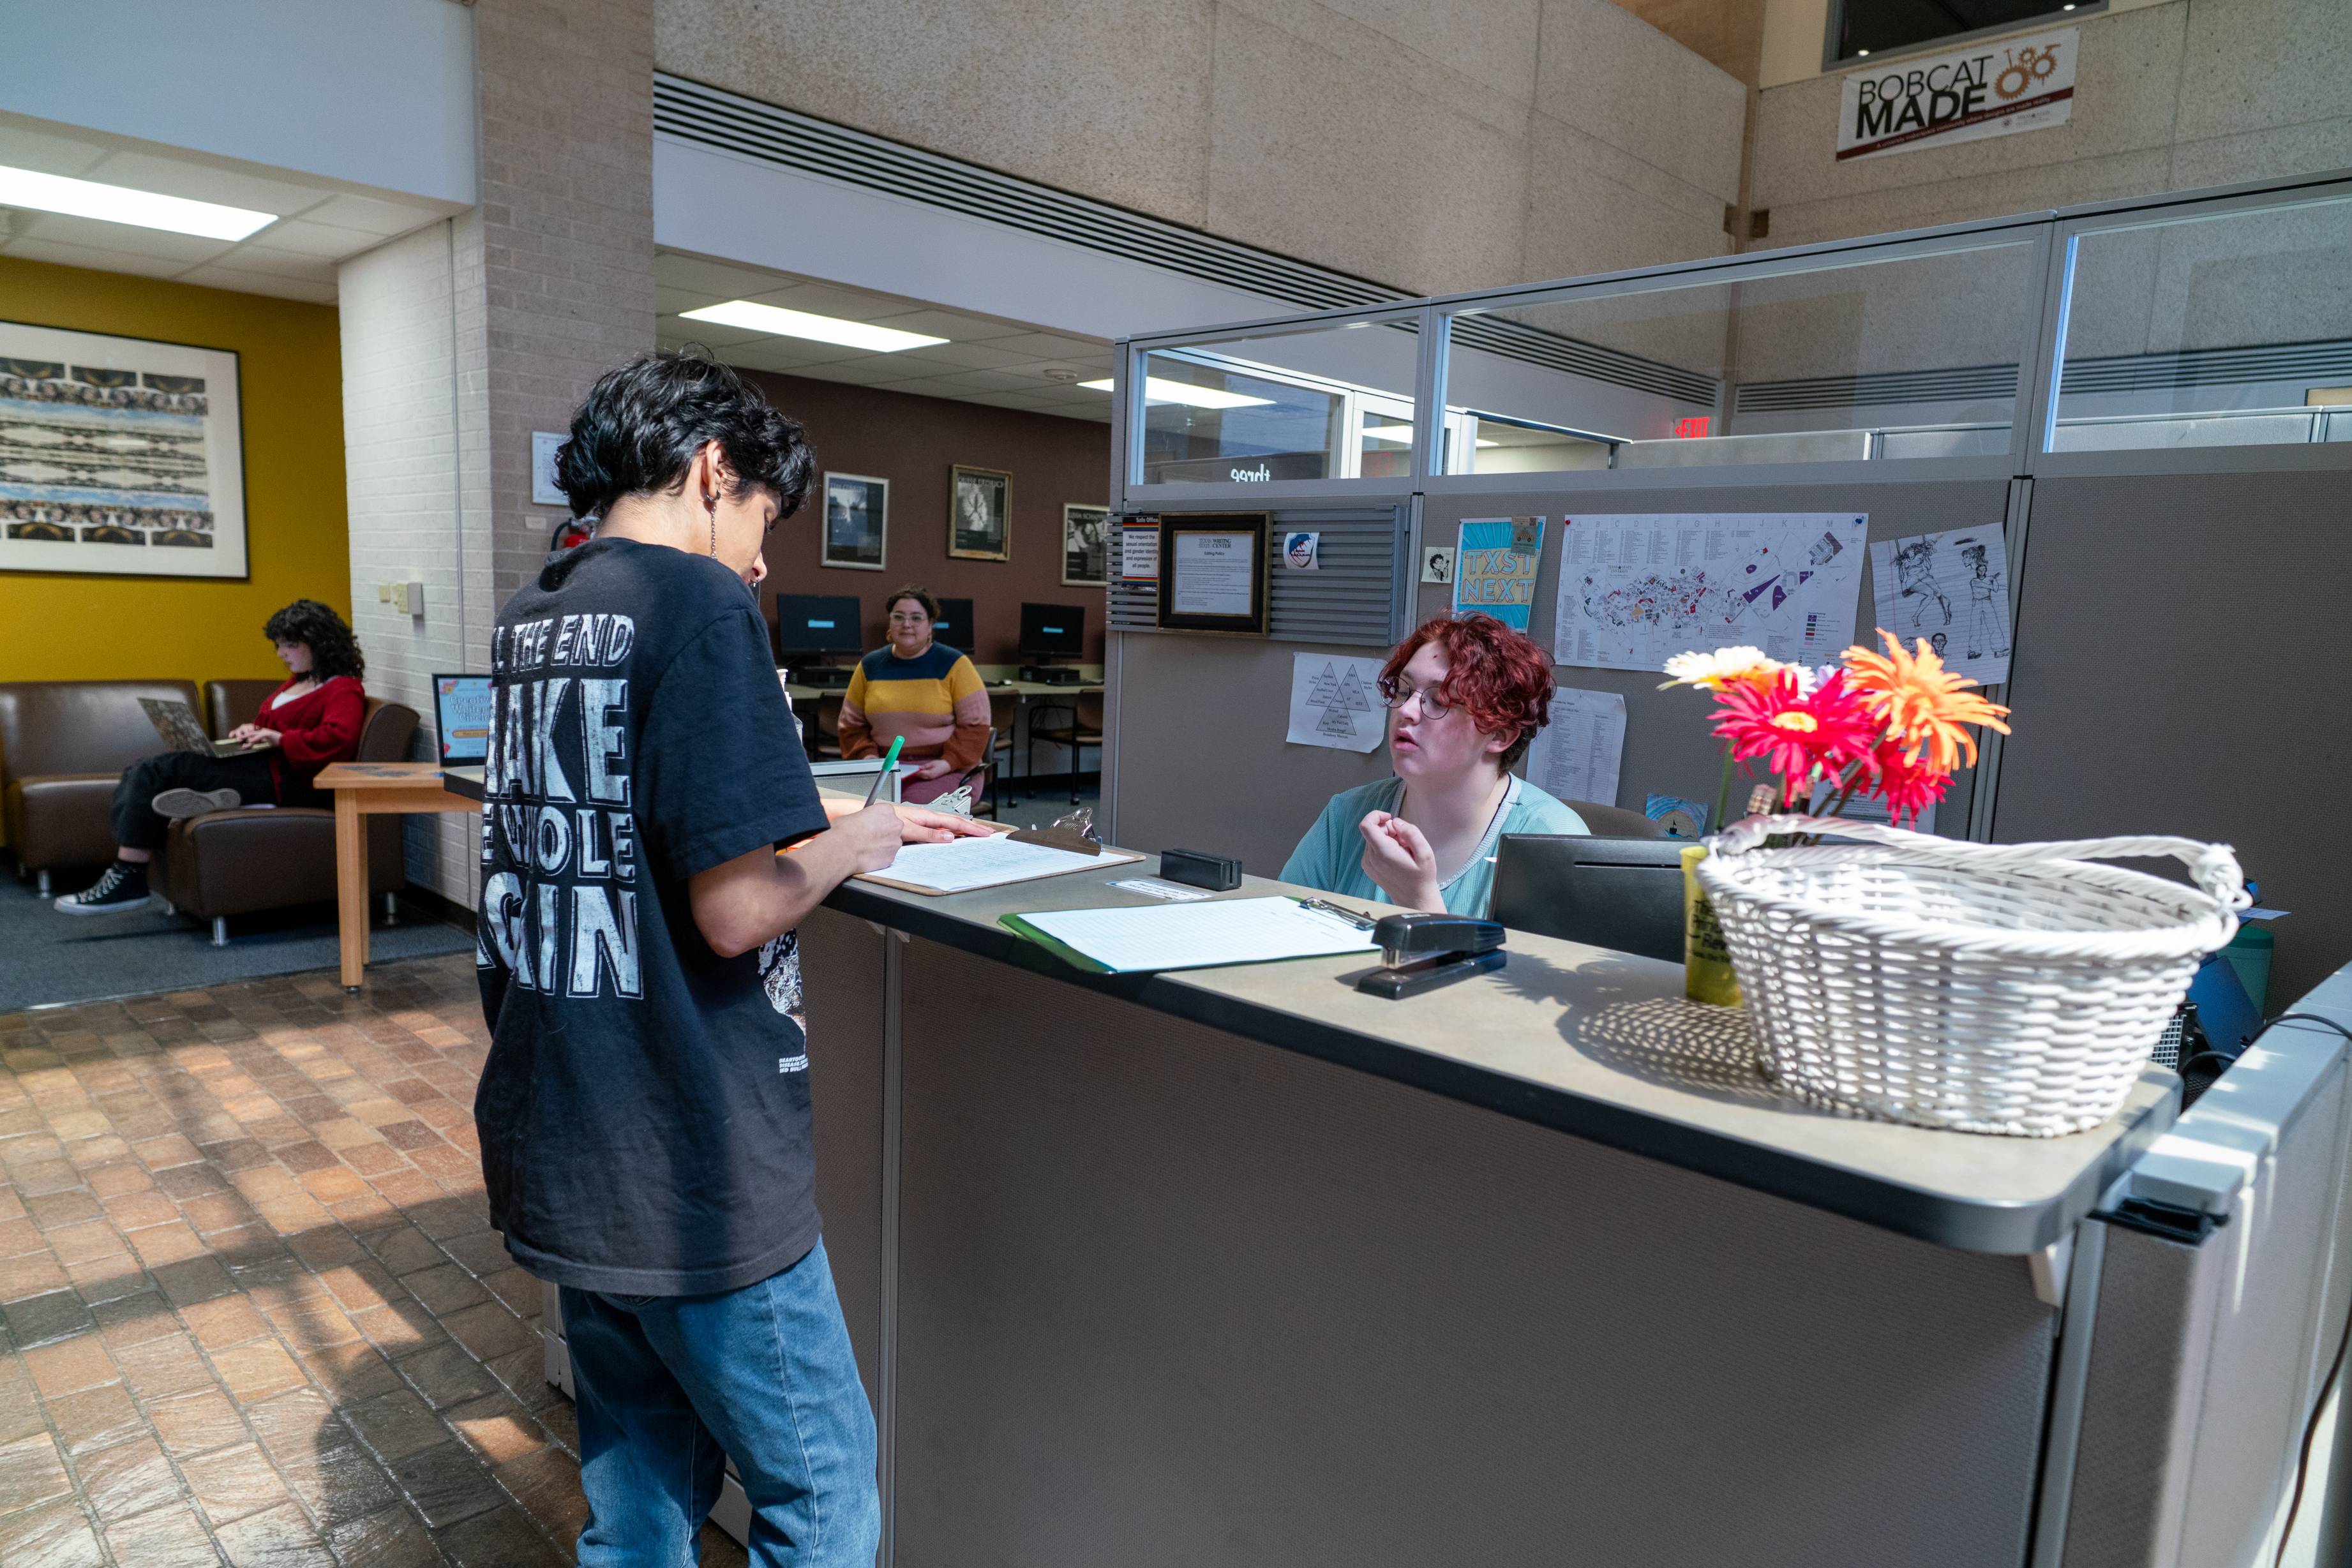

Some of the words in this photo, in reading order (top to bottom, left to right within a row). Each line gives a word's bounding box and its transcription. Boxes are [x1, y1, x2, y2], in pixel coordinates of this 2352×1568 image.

[1859, 55, 1994, 105] BOBCAT
[1855, 83, 1988, 139] MADE
[1681, 417, 1710, 438] EXIT
[1465, 550, 1536, 575] TXST
[1462, 578, 1534, 603] NEXT
[511, 619, 553, 673] THE
[550, 614, 634, 667] END
